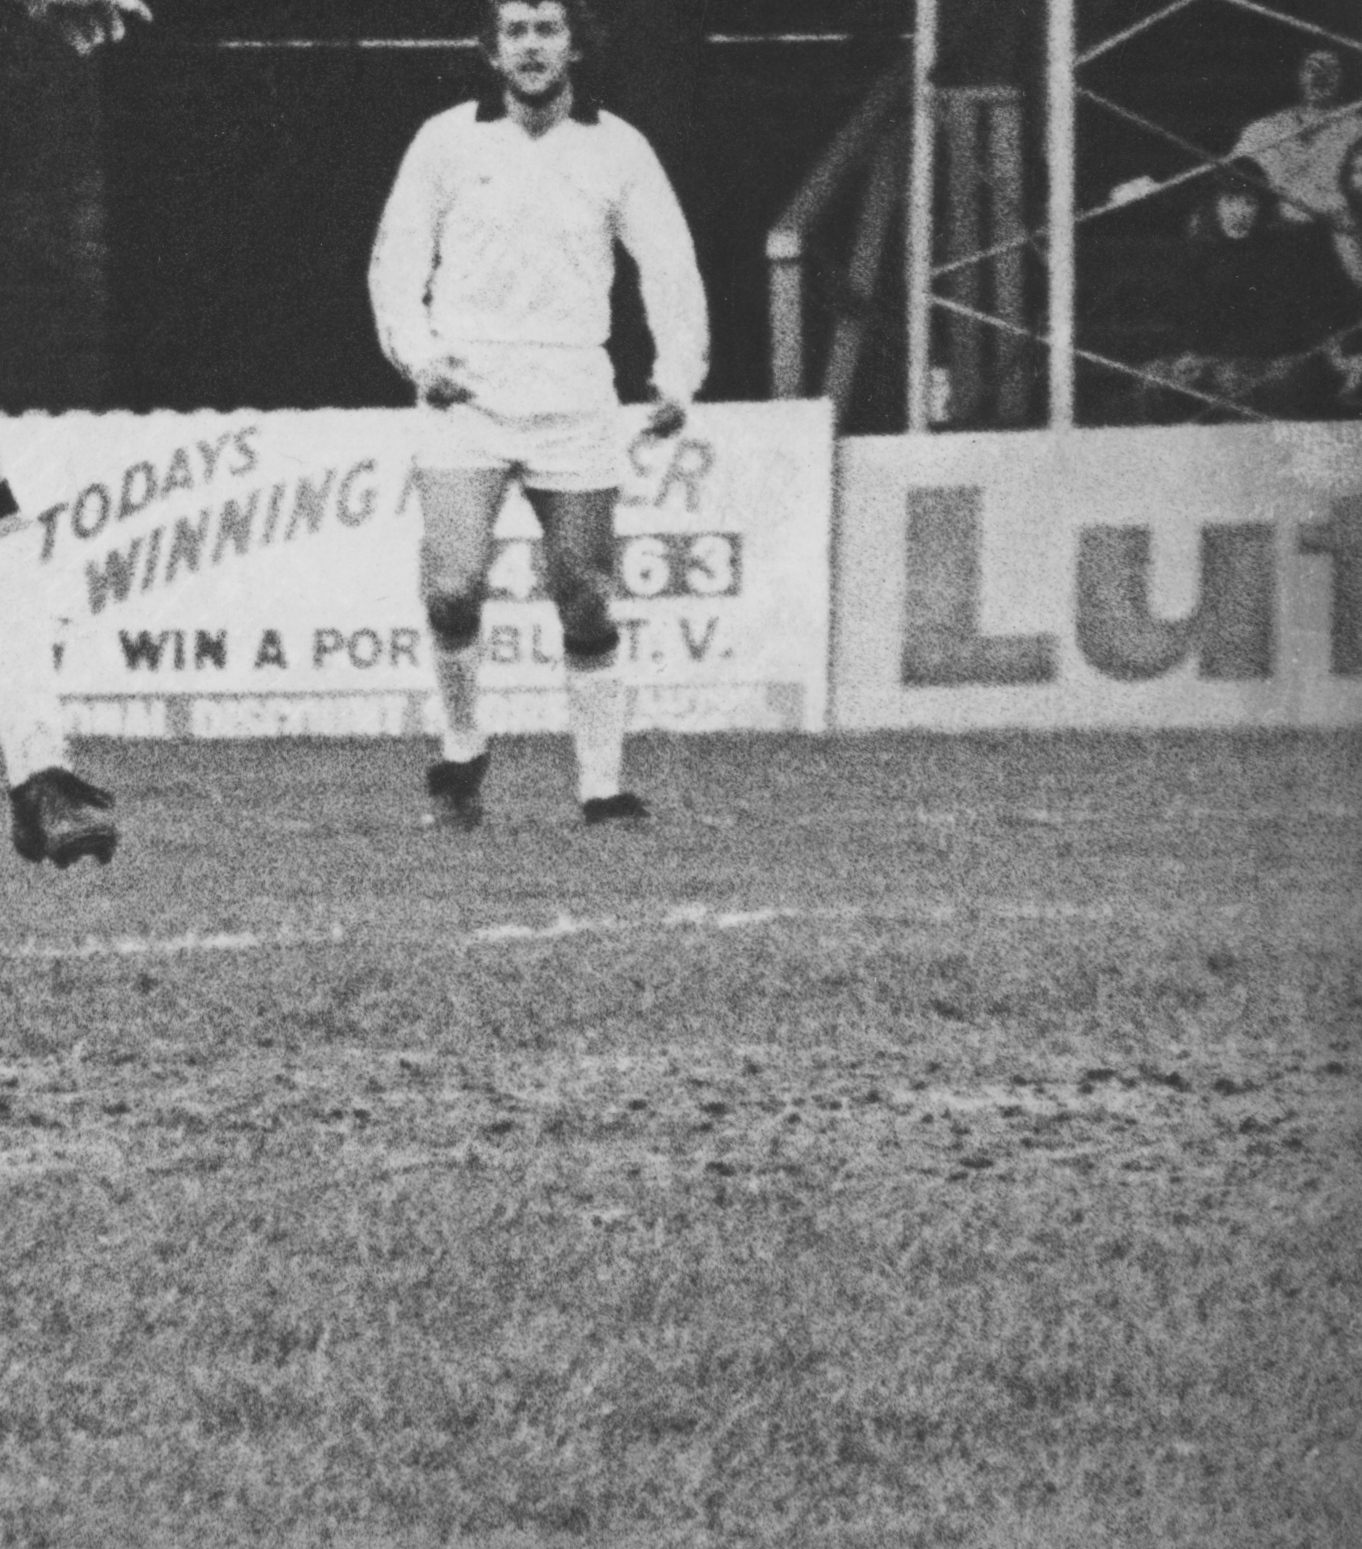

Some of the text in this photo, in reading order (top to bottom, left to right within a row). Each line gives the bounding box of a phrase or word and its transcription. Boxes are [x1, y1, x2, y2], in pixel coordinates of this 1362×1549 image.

[86, 458, 376, 616] WINNING
[485, 536, 738, 599] 463
[119, 628, 228, 673] WIN
[254, 628, 288, 671] A
[312, 623, 562, 670] PORBL
